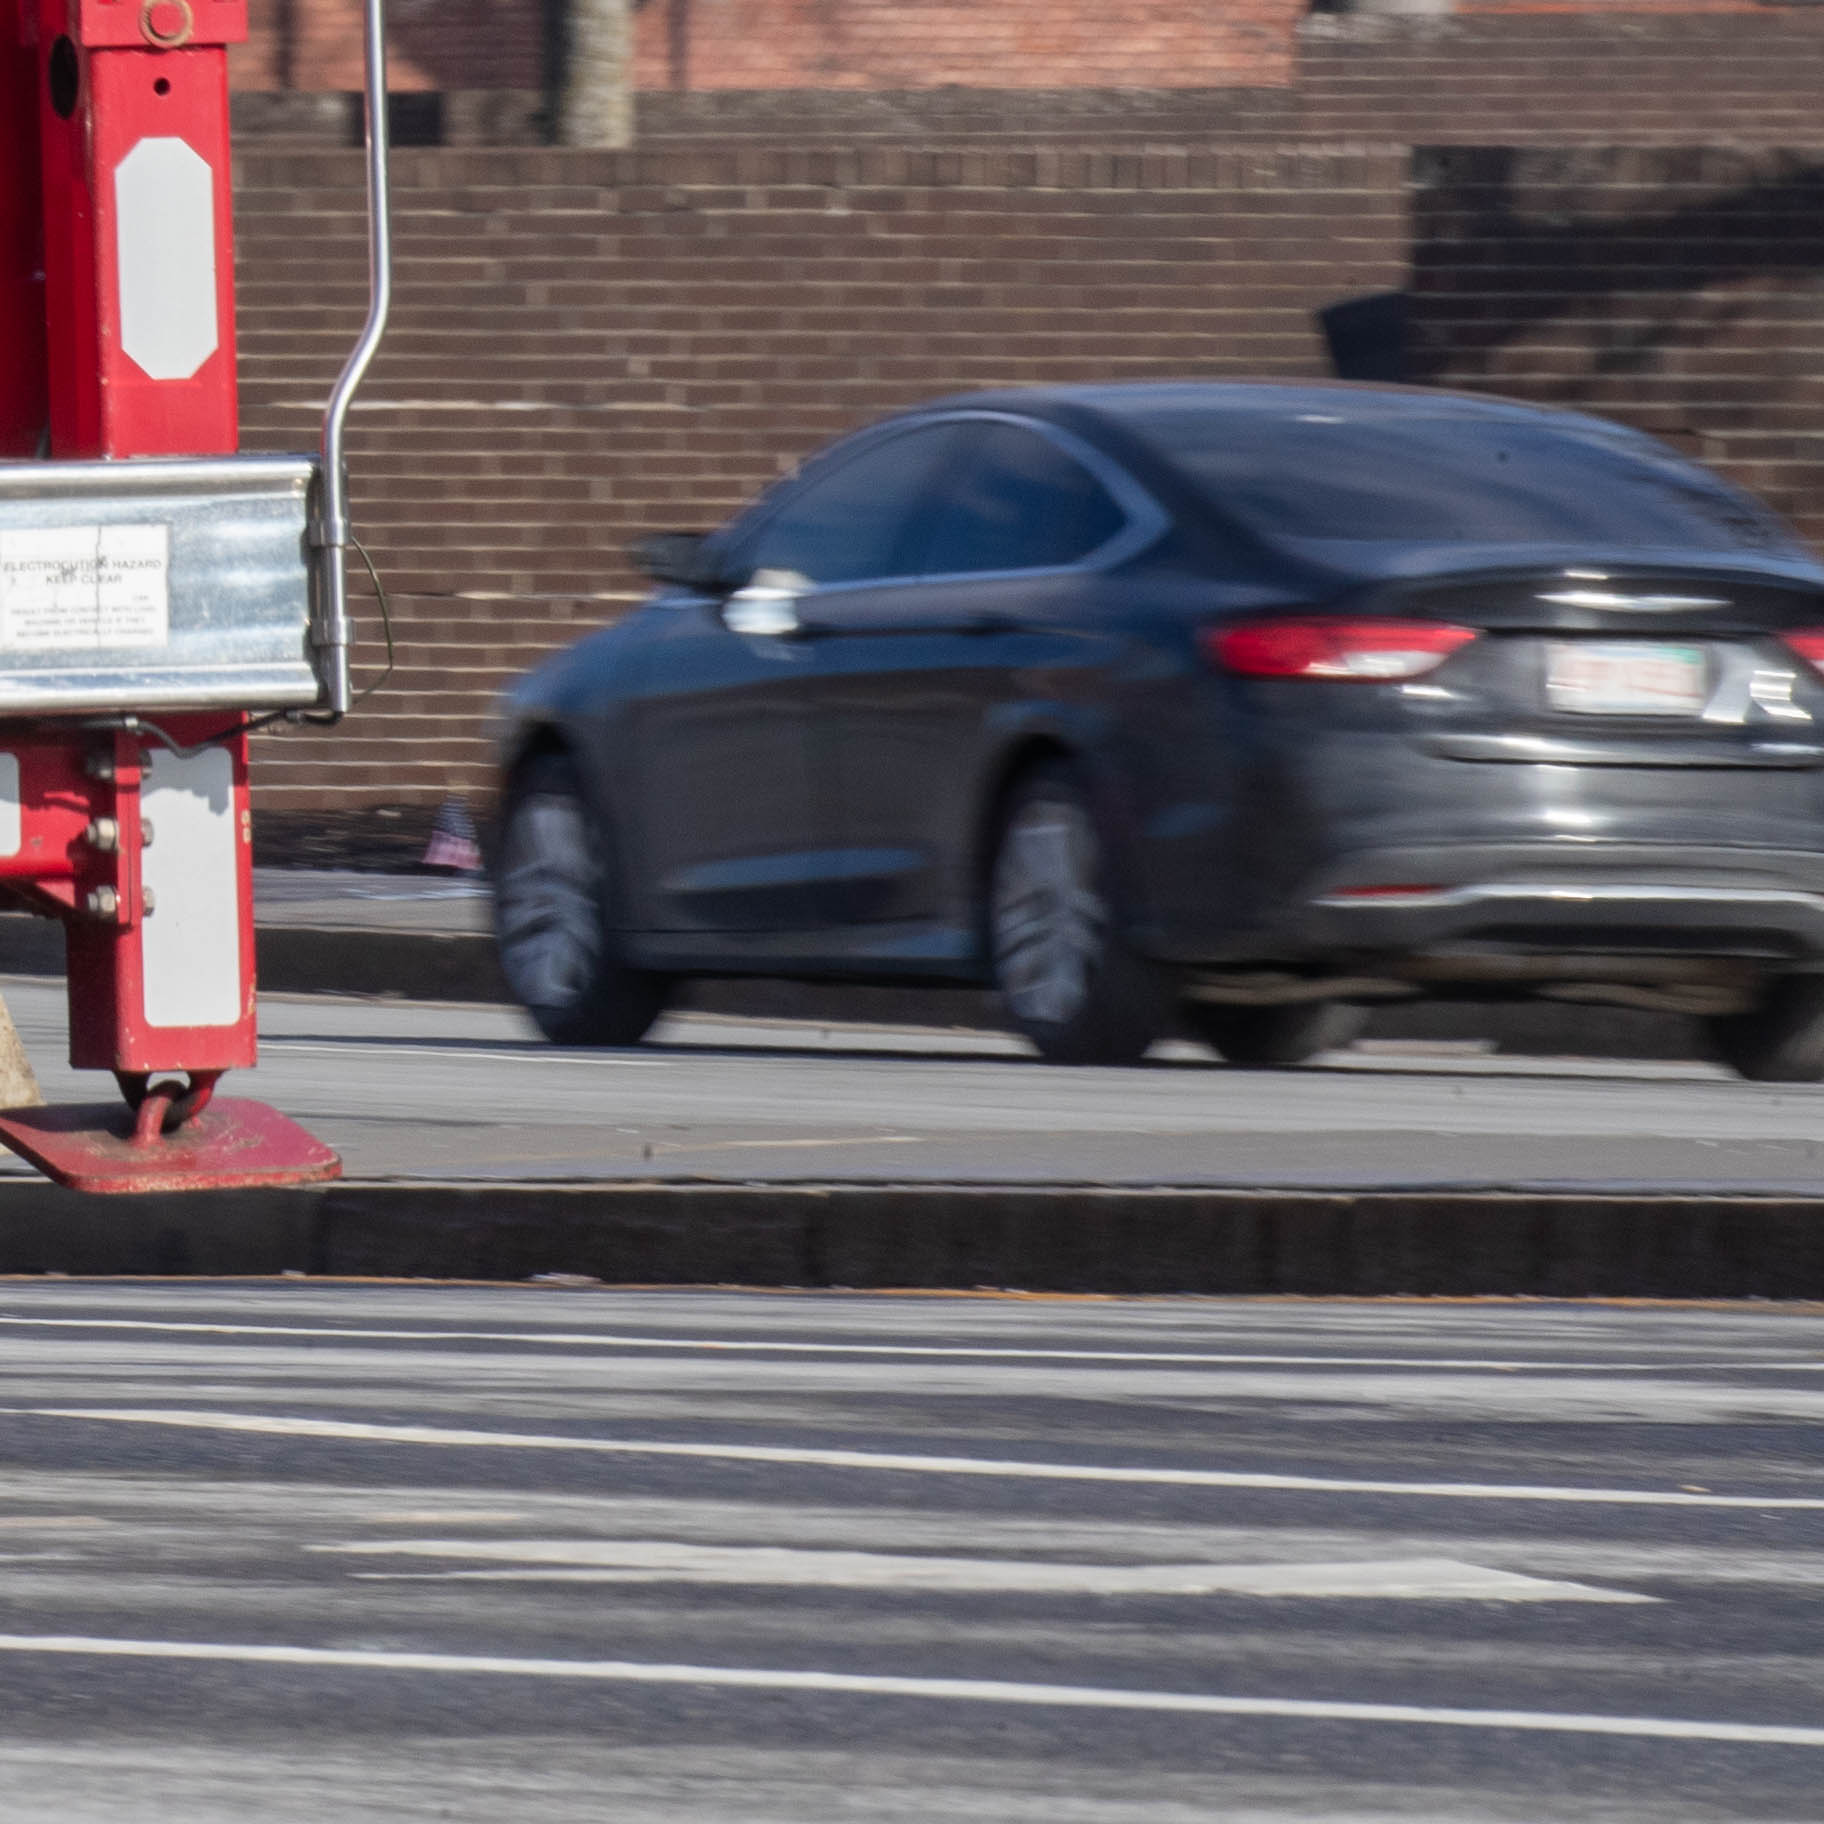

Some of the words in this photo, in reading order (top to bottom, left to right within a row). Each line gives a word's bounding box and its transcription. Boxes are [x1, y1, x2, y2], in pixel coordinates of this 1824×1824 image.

[112, 559, 163, 570] HAZARD
[46, 575, 77, 586] KEEP
[81, 575, 122, 586] CLEAR
